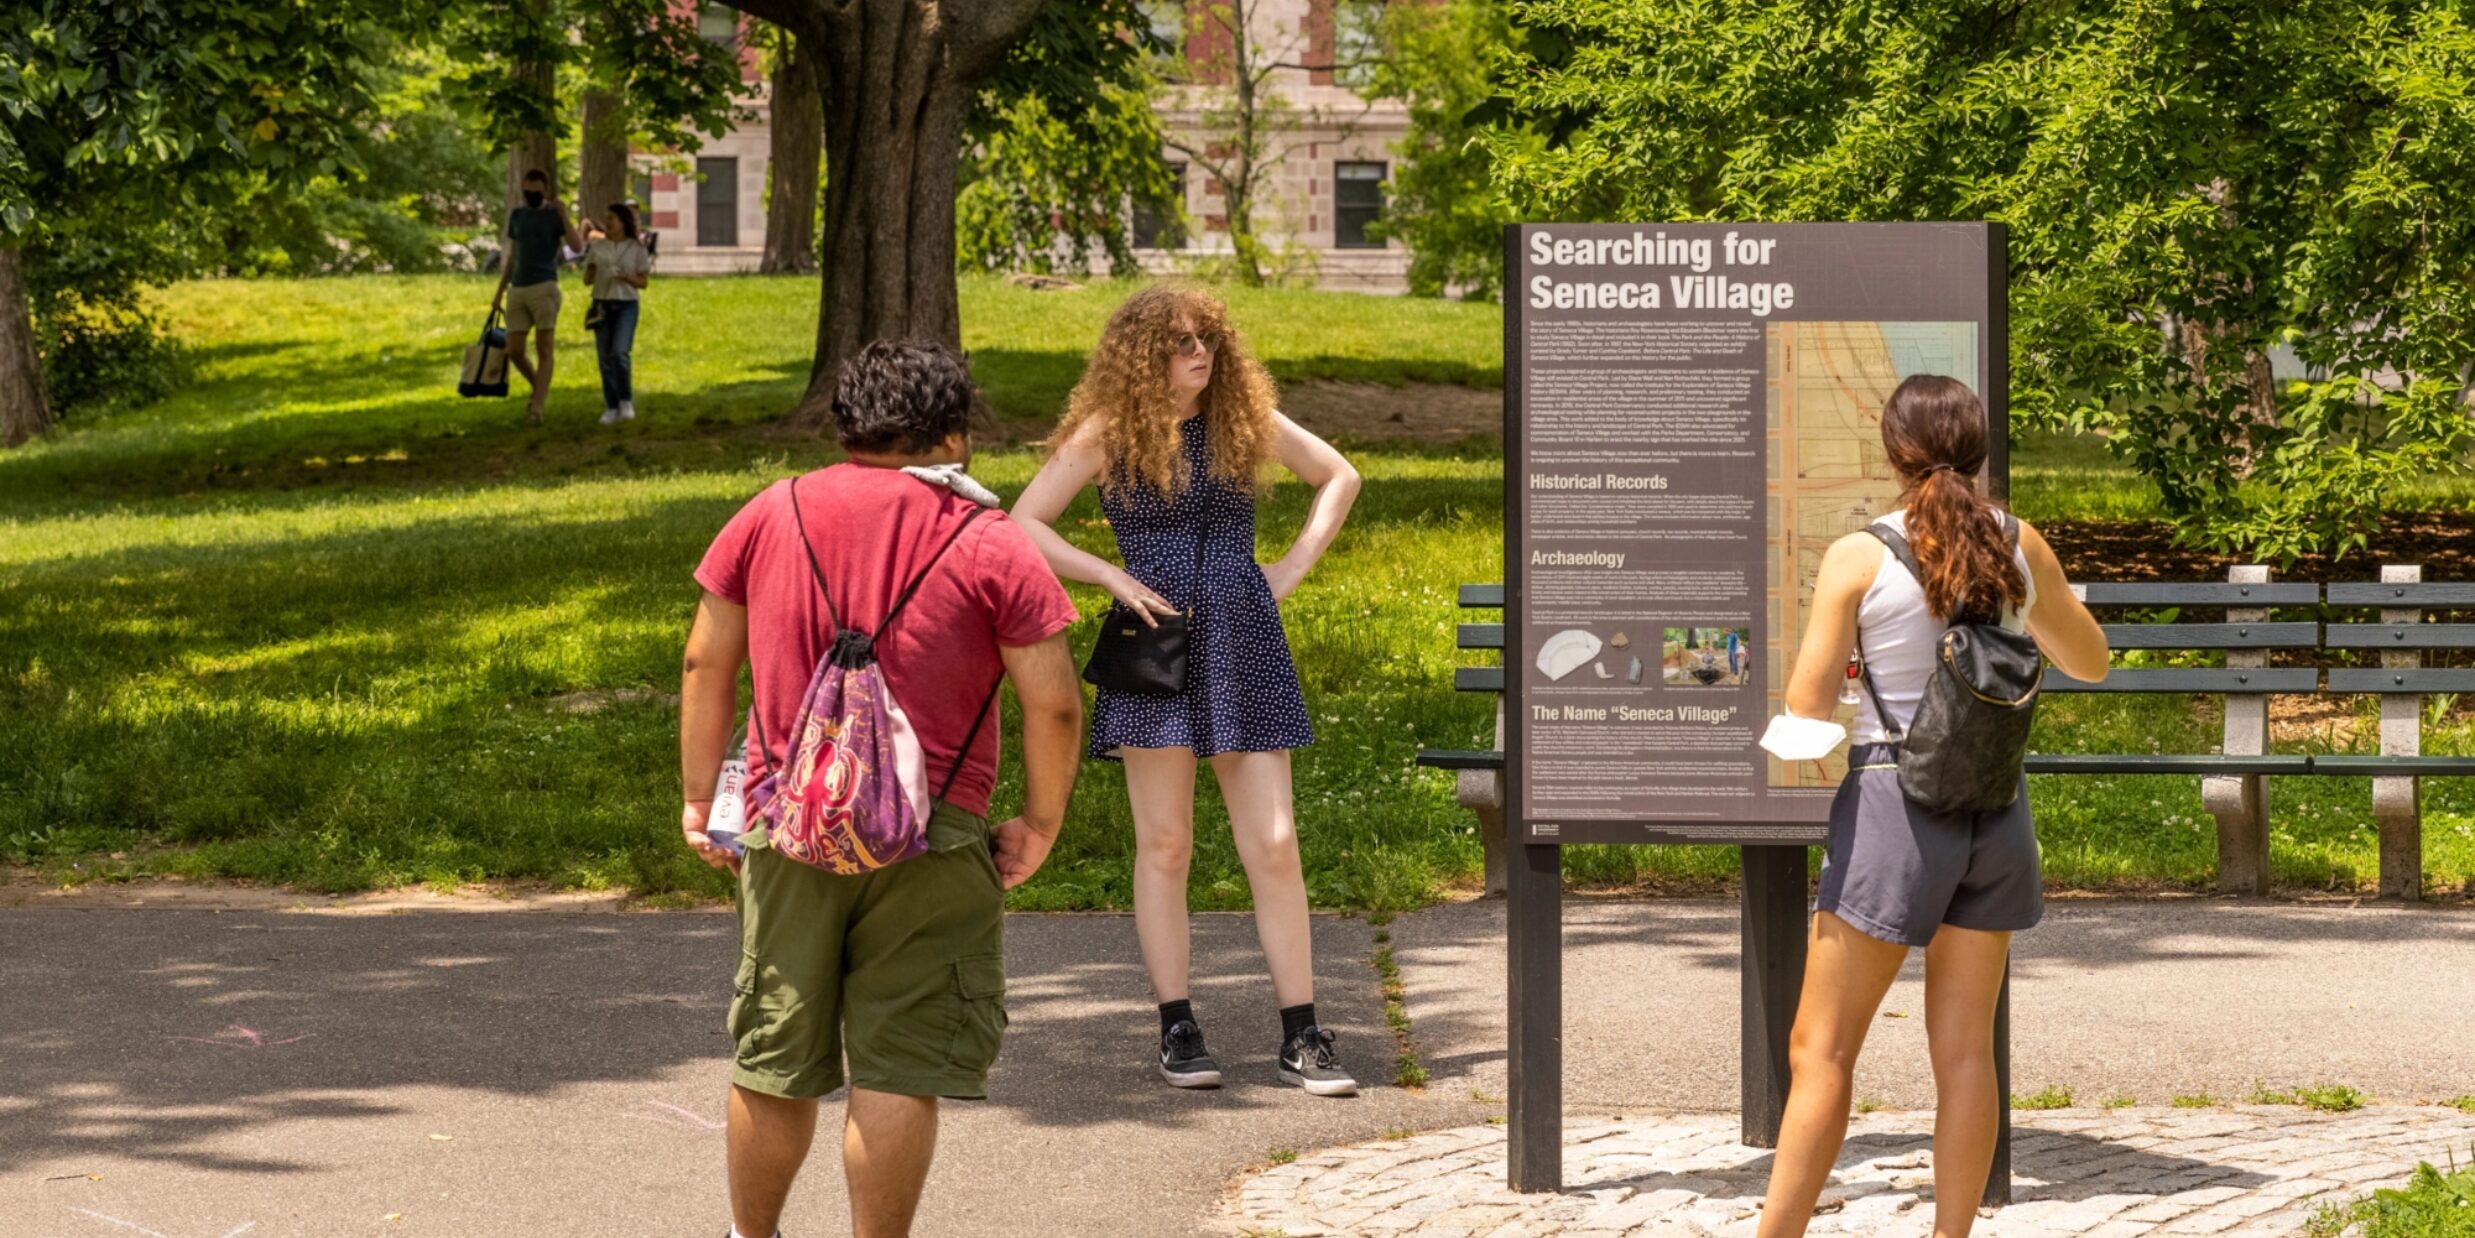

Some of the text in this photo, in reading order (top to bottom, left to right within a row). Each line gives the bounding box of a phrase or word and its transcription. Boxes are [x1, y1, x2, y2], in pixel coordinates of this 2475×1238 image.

[1530, 231, 1777, 272] Searching for
[1530, 275, 1794, 317] Seneca Village
[1530, 474, 1668, 490] Historical Records
[1531, 549, 1625, 569] Archaeology
[1531, 705, 1737, 724] The Name “Seneca Village”
[720, 775, 738, 819] evian
